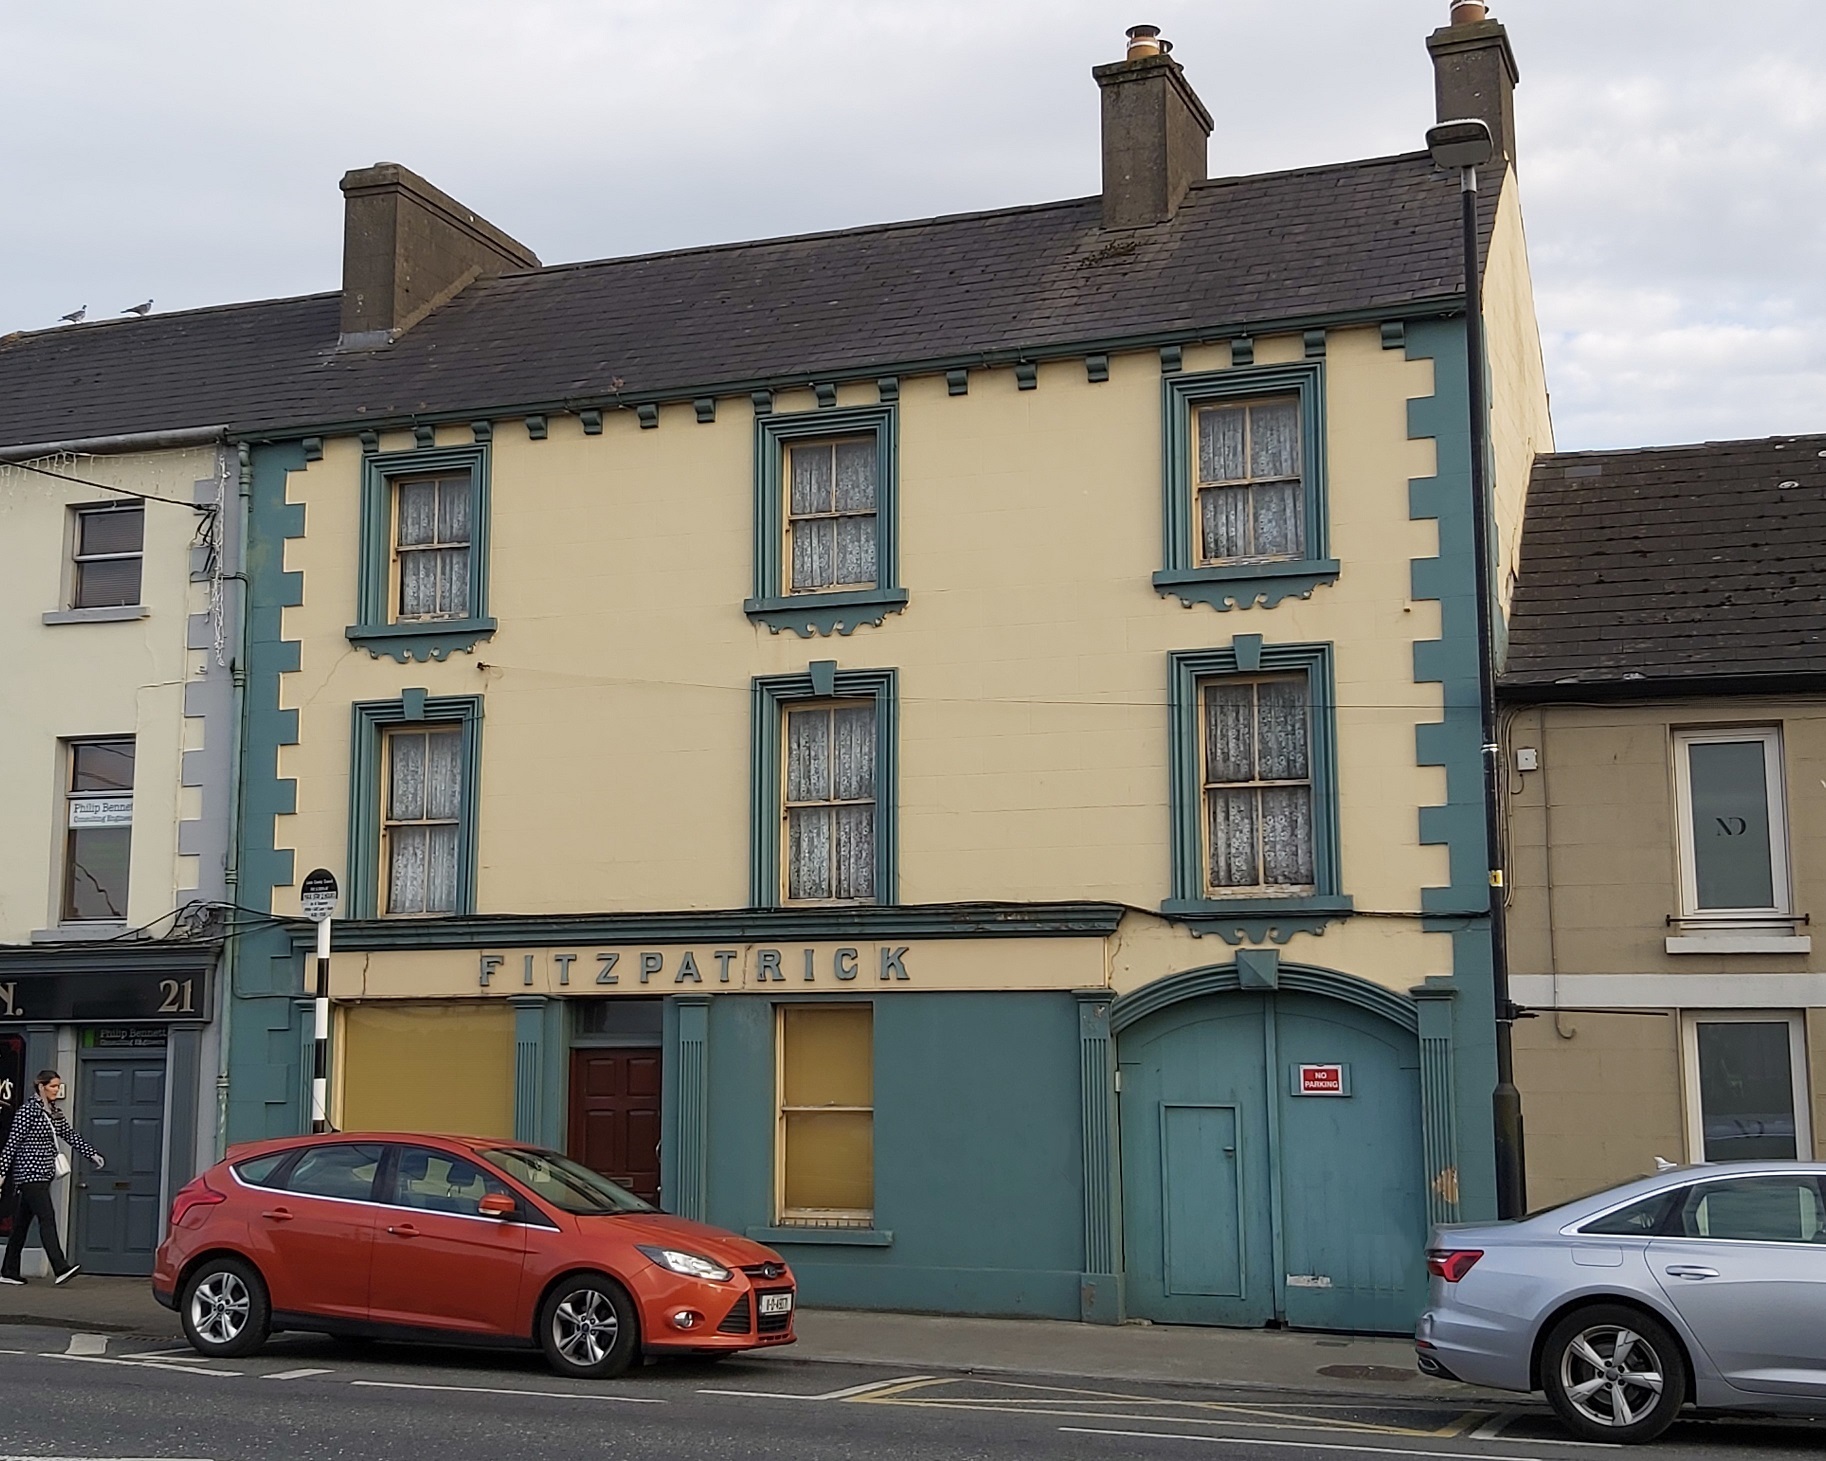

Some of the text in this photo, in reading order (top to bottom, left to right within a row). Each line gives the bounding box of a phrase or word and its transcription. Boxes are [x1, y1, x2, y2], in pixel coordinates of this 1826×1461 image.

[74, 803, 100, 814] Philip
[479, 946, 912, 987] FITZPATRICK
[158, 979, 195, 1013] 21
[100, 1028, 127, 1039] Philip
